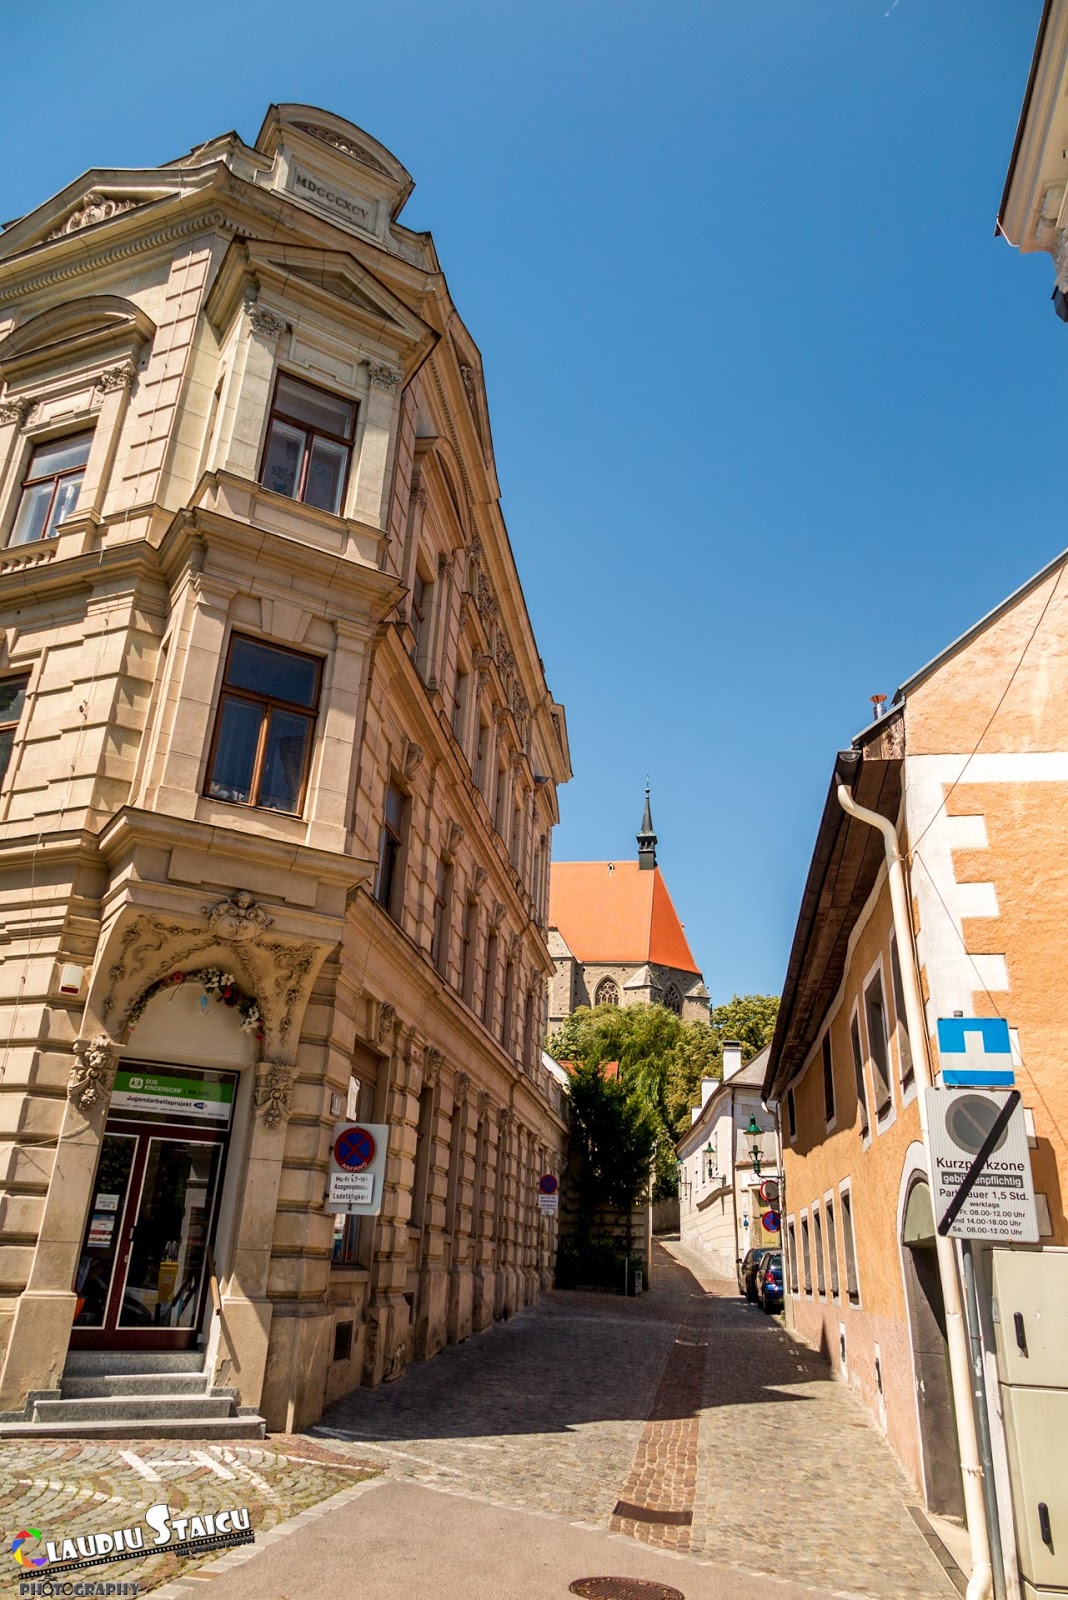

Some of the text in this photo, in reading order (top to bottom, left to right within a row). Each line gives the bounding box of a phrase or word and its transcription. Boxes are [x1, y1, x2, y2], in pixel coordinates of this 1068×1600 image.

[296, 174, 369, 220] MDCCCXCV
[144, 1085, 183, 1094] KINDERDORF
[126, 1095, 192, 1108] Jugendarbeitsprojekt
[341, 1161, 367, 1171] ANFANG
[936, 1157, 1025, 1172] Kurzpkzone
[992, 1191, 1007, 1201] 1,5
[1009, 1191, 1029, 1201] Std.
[969, 1201, 1000, 1209] werktags
[969, 1209, 1012, 1218] 08.00-12.00
[966, 1218, 1009, 1227] 14.00-18.00
[966, 1226, 1010, 1235] 08.00-12.00
